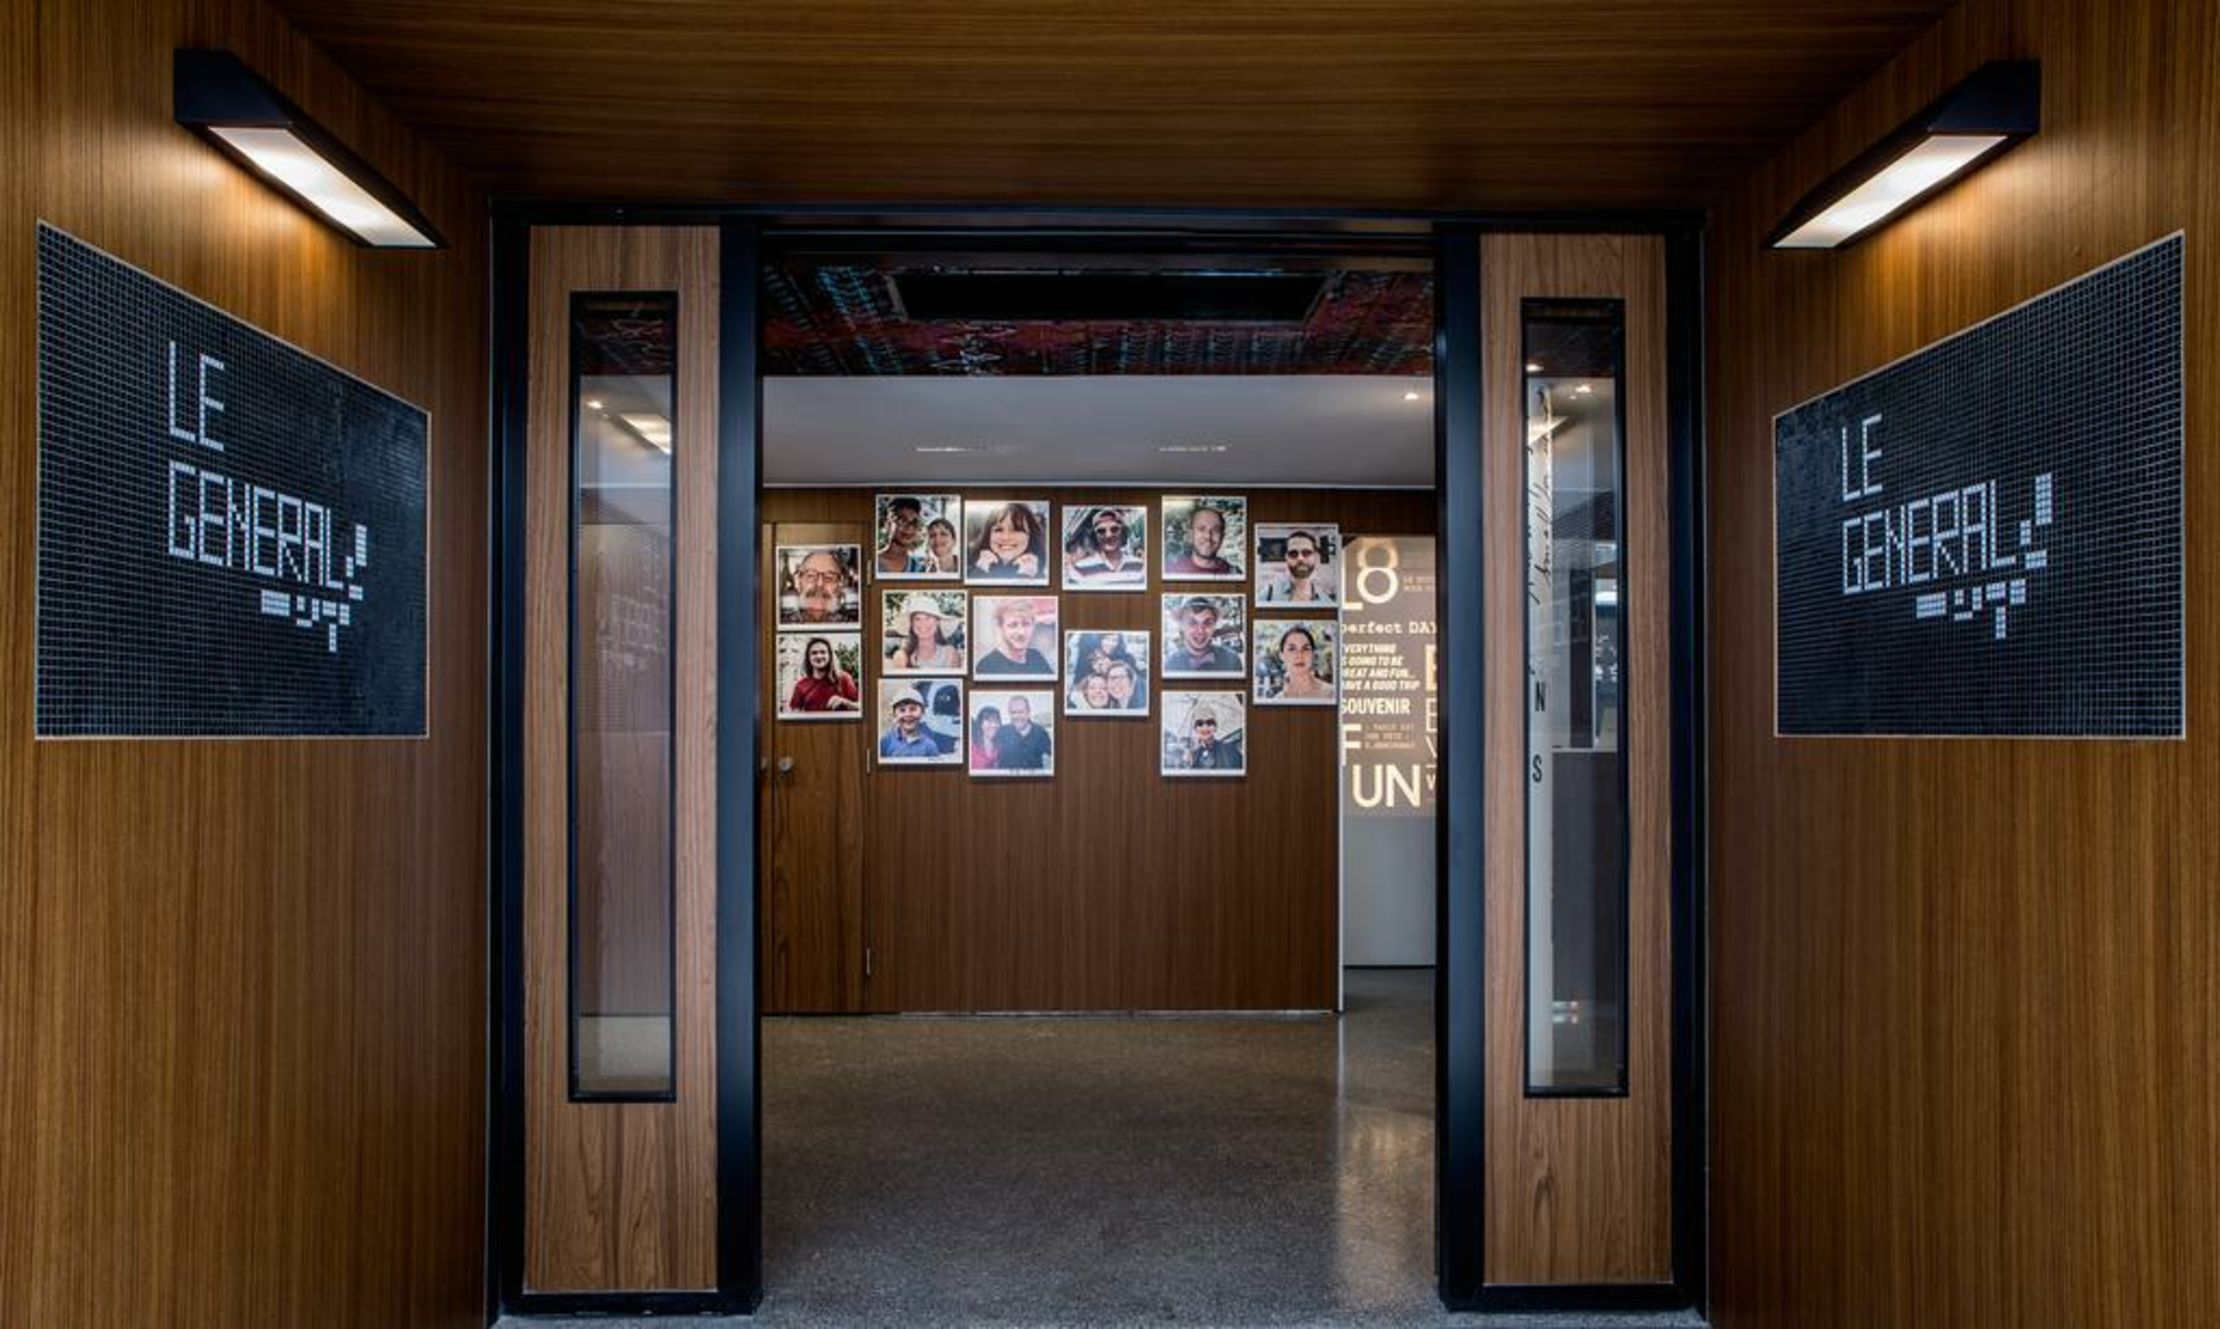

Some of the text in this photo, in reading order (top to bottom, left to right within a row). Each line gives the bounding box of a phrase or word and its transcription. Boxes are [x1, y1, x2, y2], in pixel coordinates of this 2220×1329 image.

[169, 340, 225, 451] LE
[1842, 413, 1882, 501] LE
[169, 459, 344, 589] GENERAL
[1842, 479, 2016, 595] GENERAL
[1340, 621, 1403, 636] perfect
[1341, 643, 1397, 654] VERYTHING
[1340, 697, 1411, 715] SOUVENIR
[1341, 680, 1362, 691] AVE
